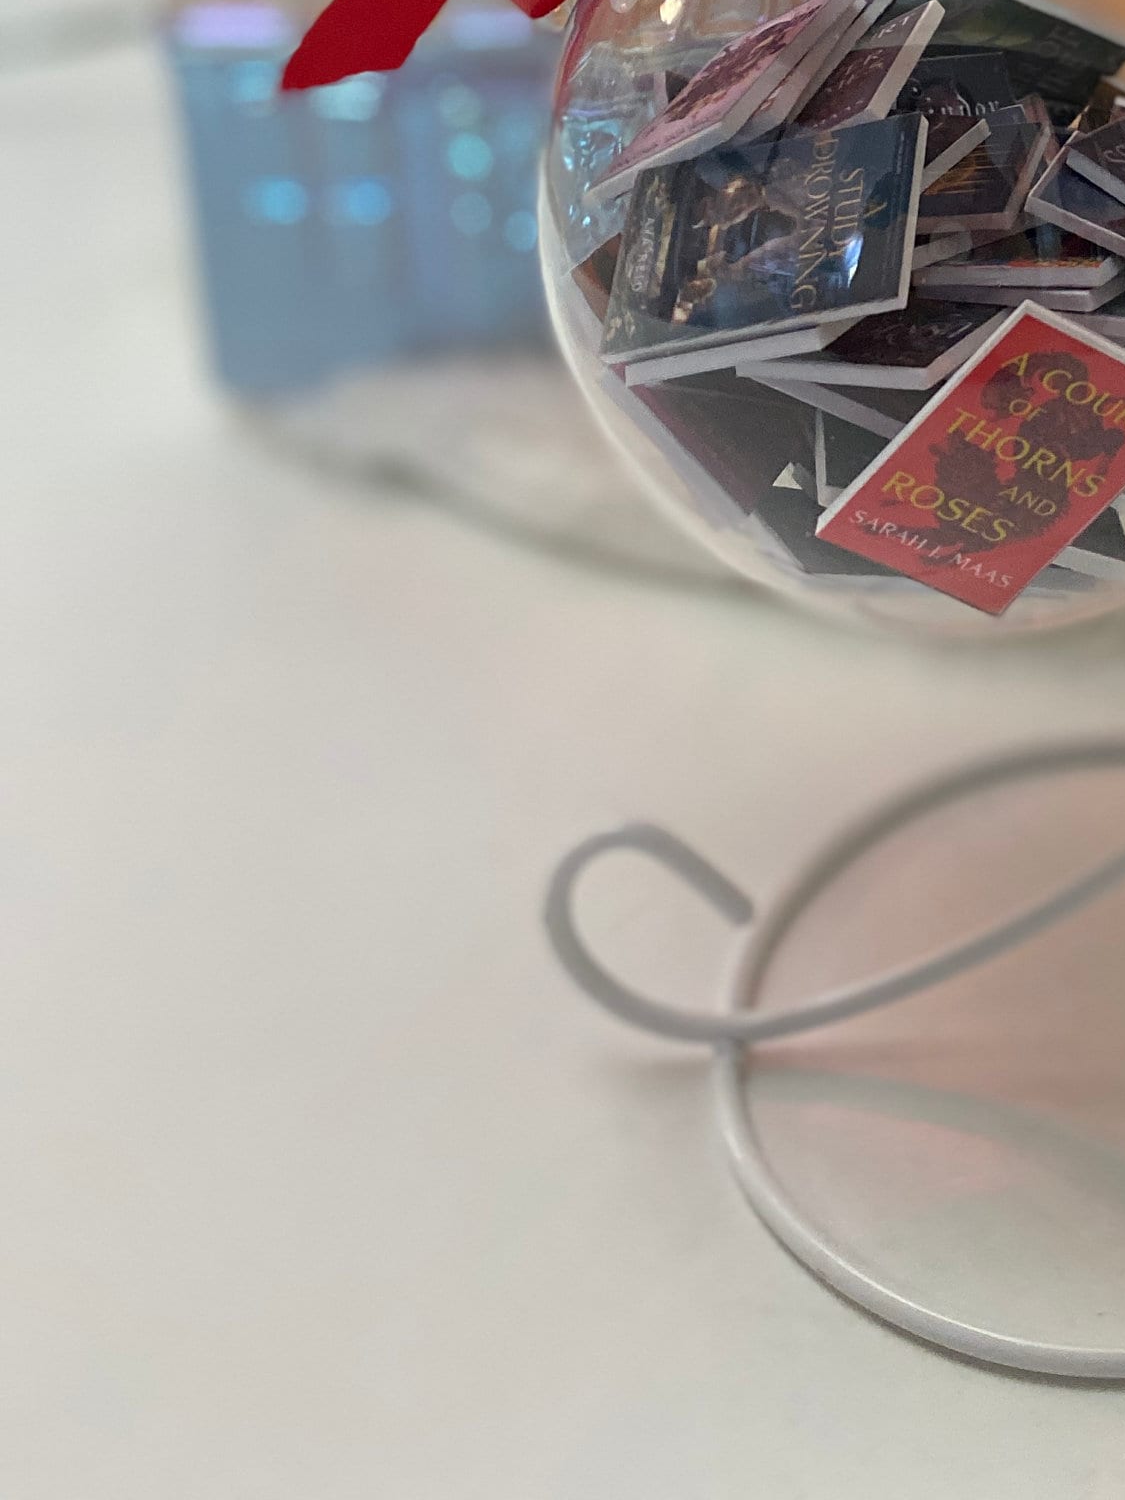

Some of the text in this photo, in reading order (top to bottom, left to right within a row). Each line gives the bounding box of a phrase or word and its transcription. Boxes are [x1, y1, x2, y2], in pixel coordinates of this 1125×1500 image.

[790, 138, 840, 310] DROWNING
[1000, 352, 1030, 377] A
[1008, 399, 1046, 422] OF
[946, 407, 1106, 498] THORNS
[880, 471, 1016, 542] ROSES
[999, 485, 1056, 516] AND
[850, 509, 928, 551] SARAH
[951, 552, 1014, 589] MAAS
